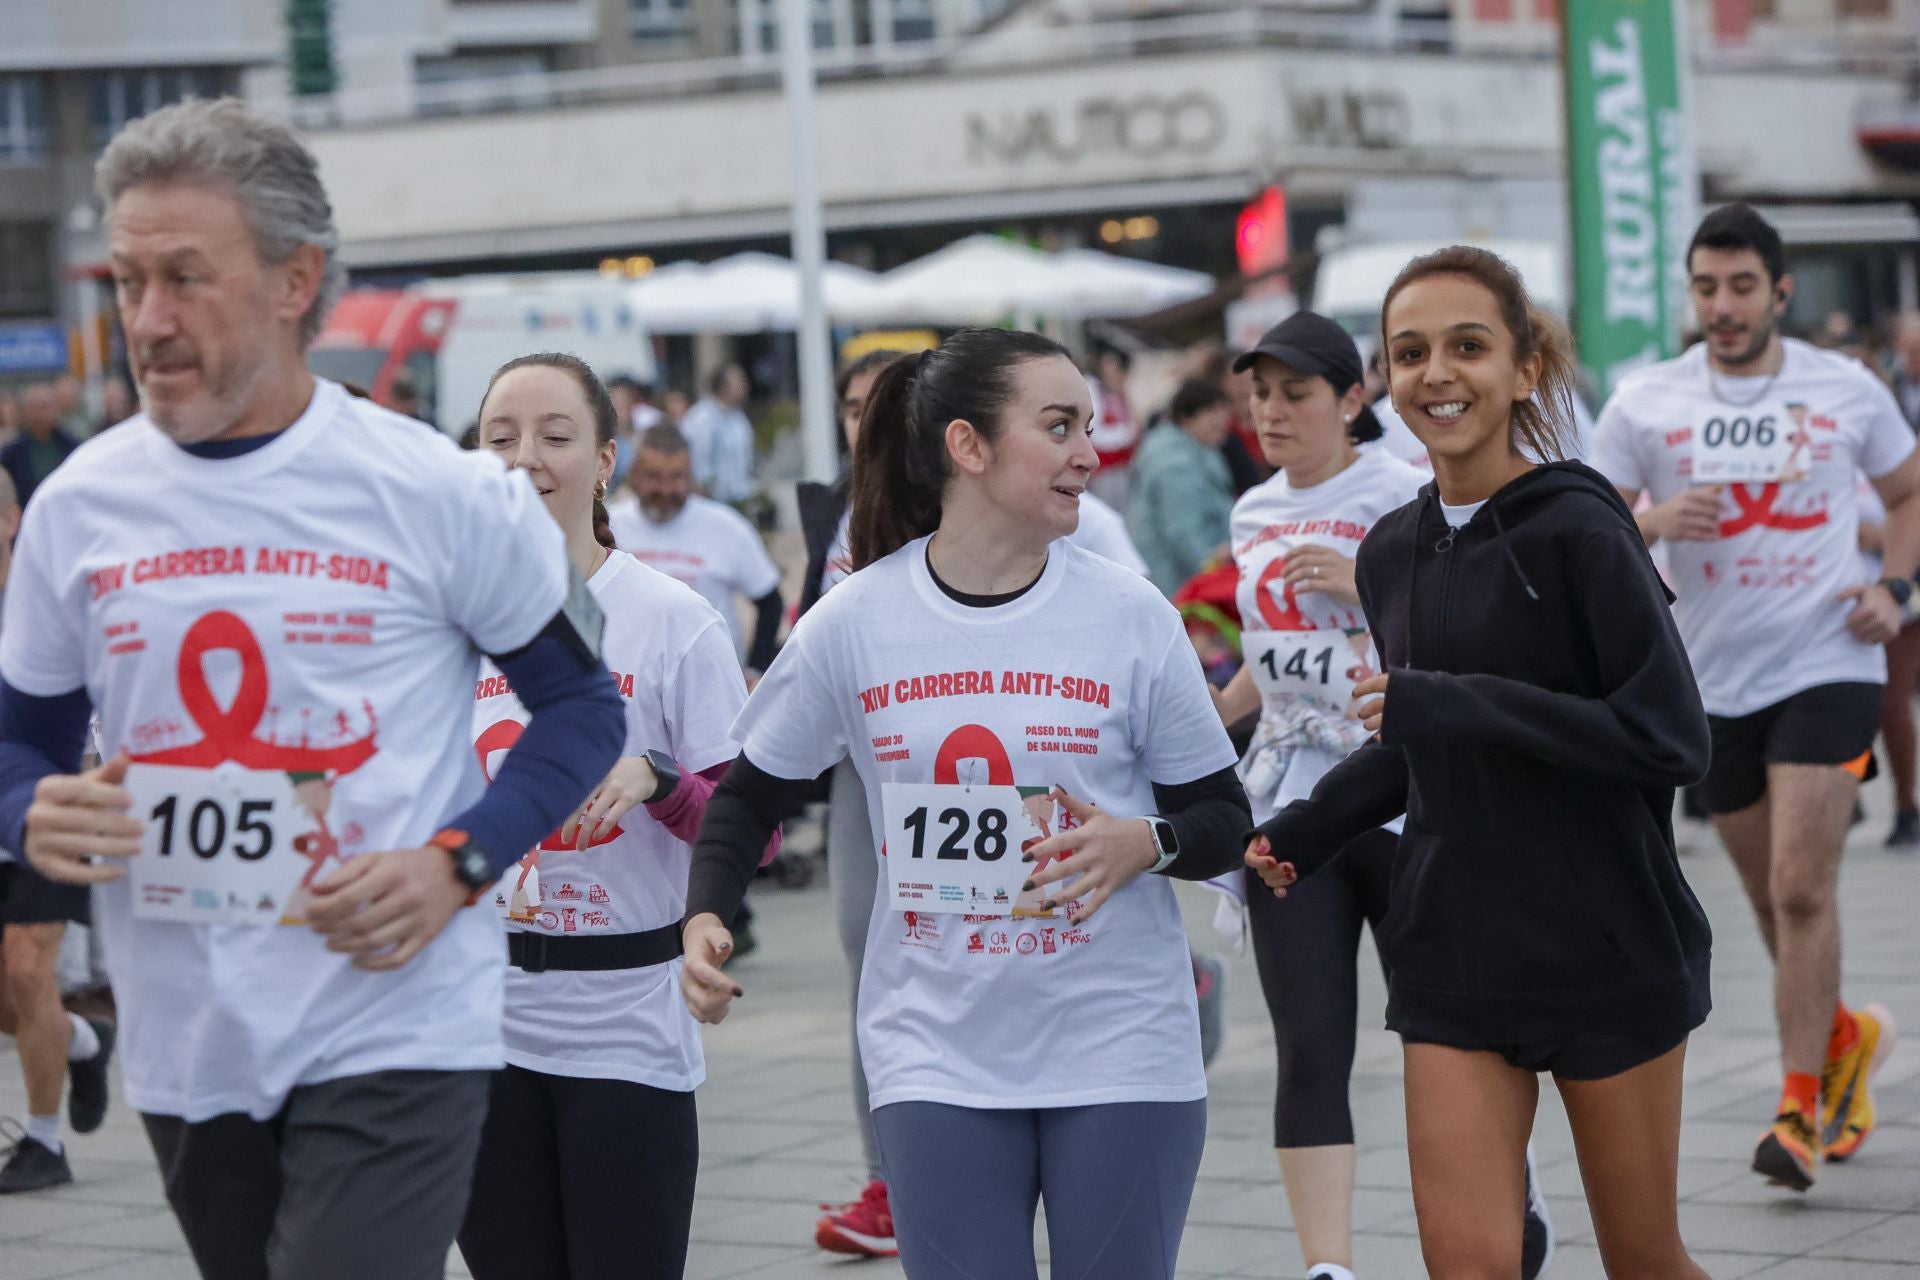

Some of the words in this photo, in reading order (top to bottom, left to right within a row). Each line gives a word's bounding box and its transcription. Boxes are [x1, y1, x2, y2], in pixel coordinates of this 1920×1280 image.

[1591, 18, 1657, 324] RURAL
[1704, 416, 1777, 448] 006
[132, 547, 246, 584] CARRERA
[255, 547, 389, 591] ANTI-SIDA
[1259, 647, 1335, 685] 141
[857, 683, 890, 714] XIV
[895, 671, 994, 704] CARRERA
[1000, 671, 1110, 709] ANTI-SIDA
[893, 734, 903, 746] 30
[1025, 726, 1055, 736] PASEO
[1057, 726, 1073, 737] DEL
[1075, 727, 1100, 740] MURO
[1027, 741, 1039, 752] DE
[1041, 741, 1060, 752] SAN
[1062, 742, 1098, 755] LORENZO
[150, 796, 274, 862] 105
[903, 806, 1008, 862] 128
[988, 946, 1010, 954] MDN
